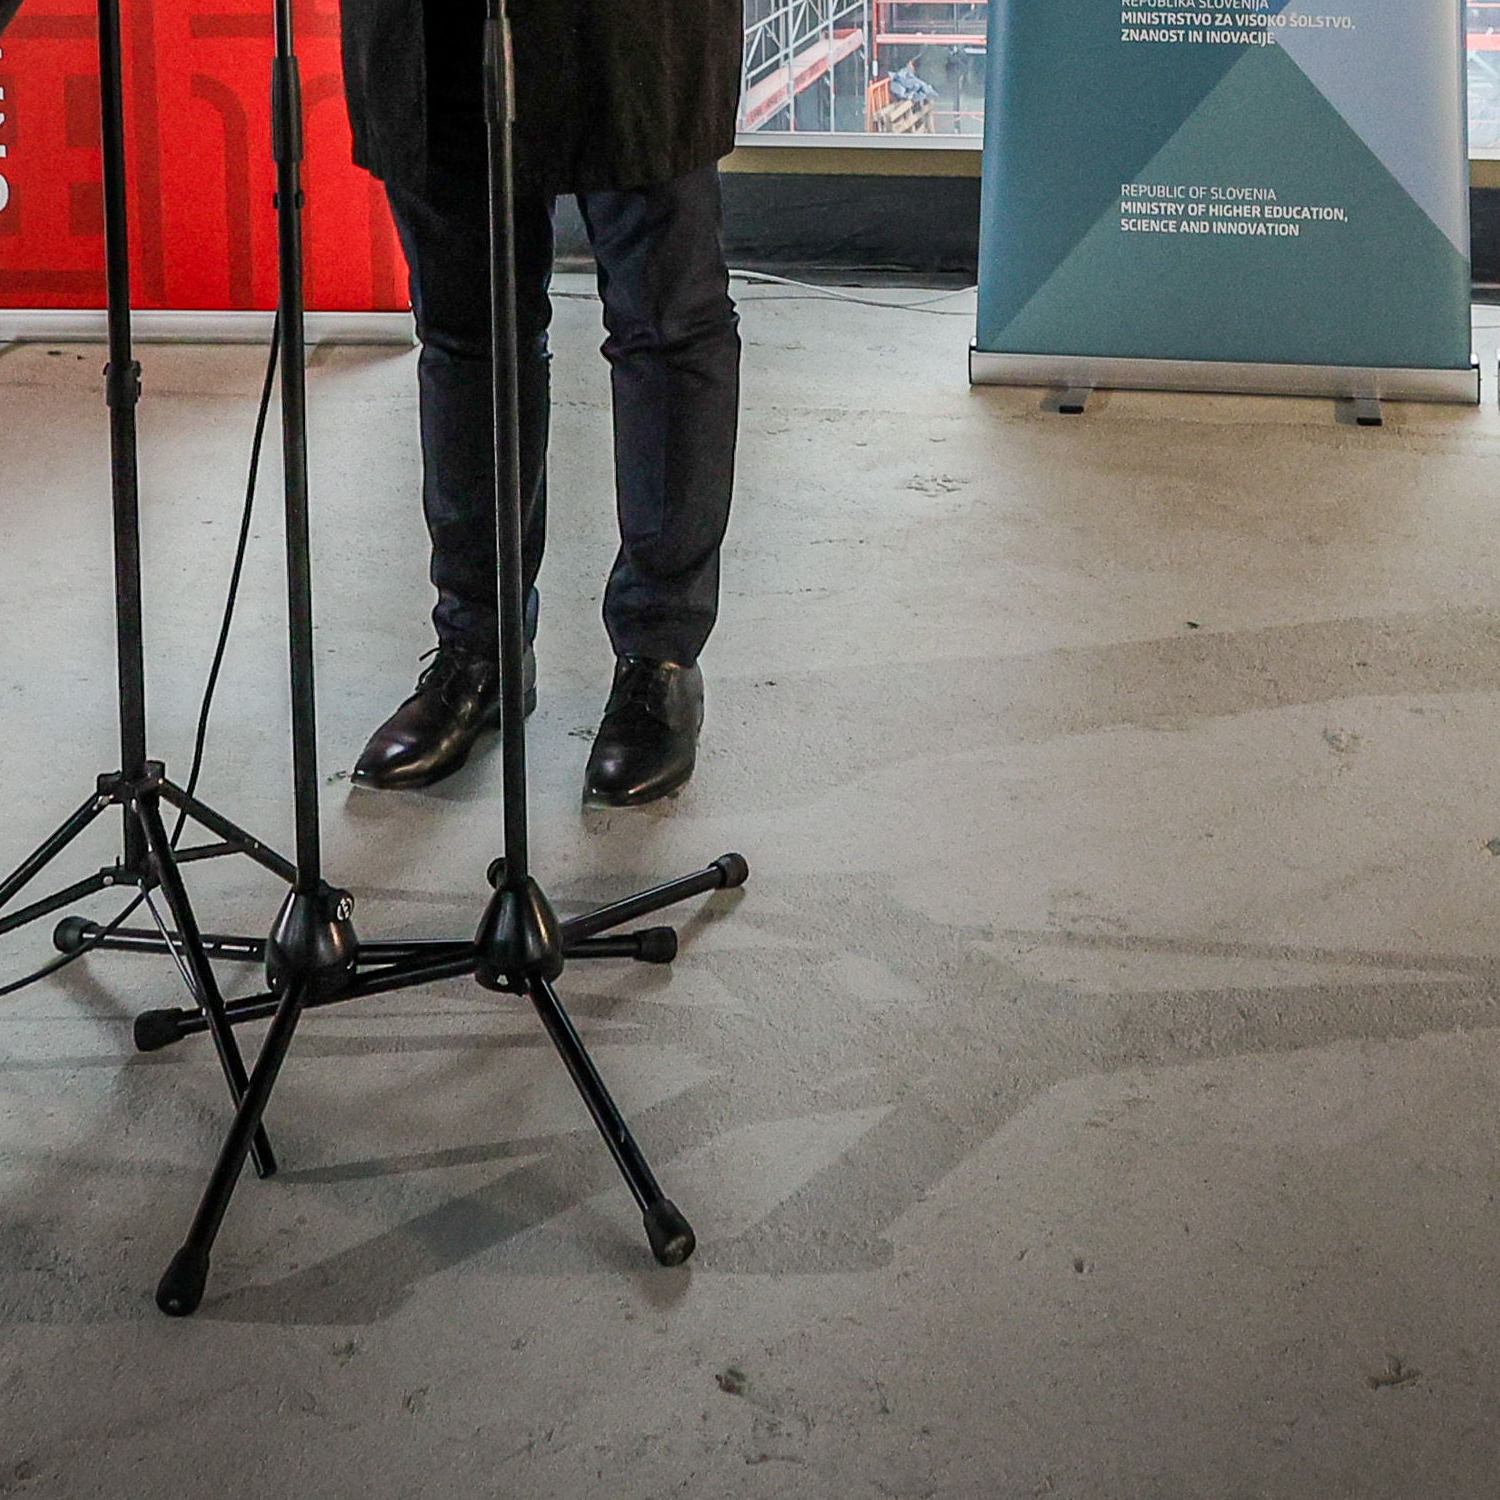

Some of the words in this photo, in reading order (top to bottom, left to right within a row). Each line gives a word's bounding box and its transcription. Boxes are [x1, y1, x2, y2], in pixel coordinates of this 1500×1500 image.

[1121, 12, 1212, 26] MINISTRSTVO
[1214, 12, 1233, 26] ZA
[1235, 13, 1287, 28] VISOKO
[1289, 11, 1356, 30] ŠOLSTVO,
[1121, 30, 1186, 43] ZNANOST
[1188, 30, 1203, 43] IN
[1206, 30, 1275, 47] INOVACIJE
[1120, 184, 1185, 199] REPUBLIC
[1188, 185, 1206, 200] OF
[1210, 186, 1277, 201] SLOVENIA
[1120, 202, 1185, 216] MINISTRY
[1187, 203, 1205, 217] OF
[1209, 203, 1262, 219] HIGHER
[1264, 204, 1349, 222] EDUCATION,
[1120, 219, 1177, 233] SCIENCE
[1179, 220, 1210, 234] AND
[1212, 220, 1300, 236] INNOVATION
